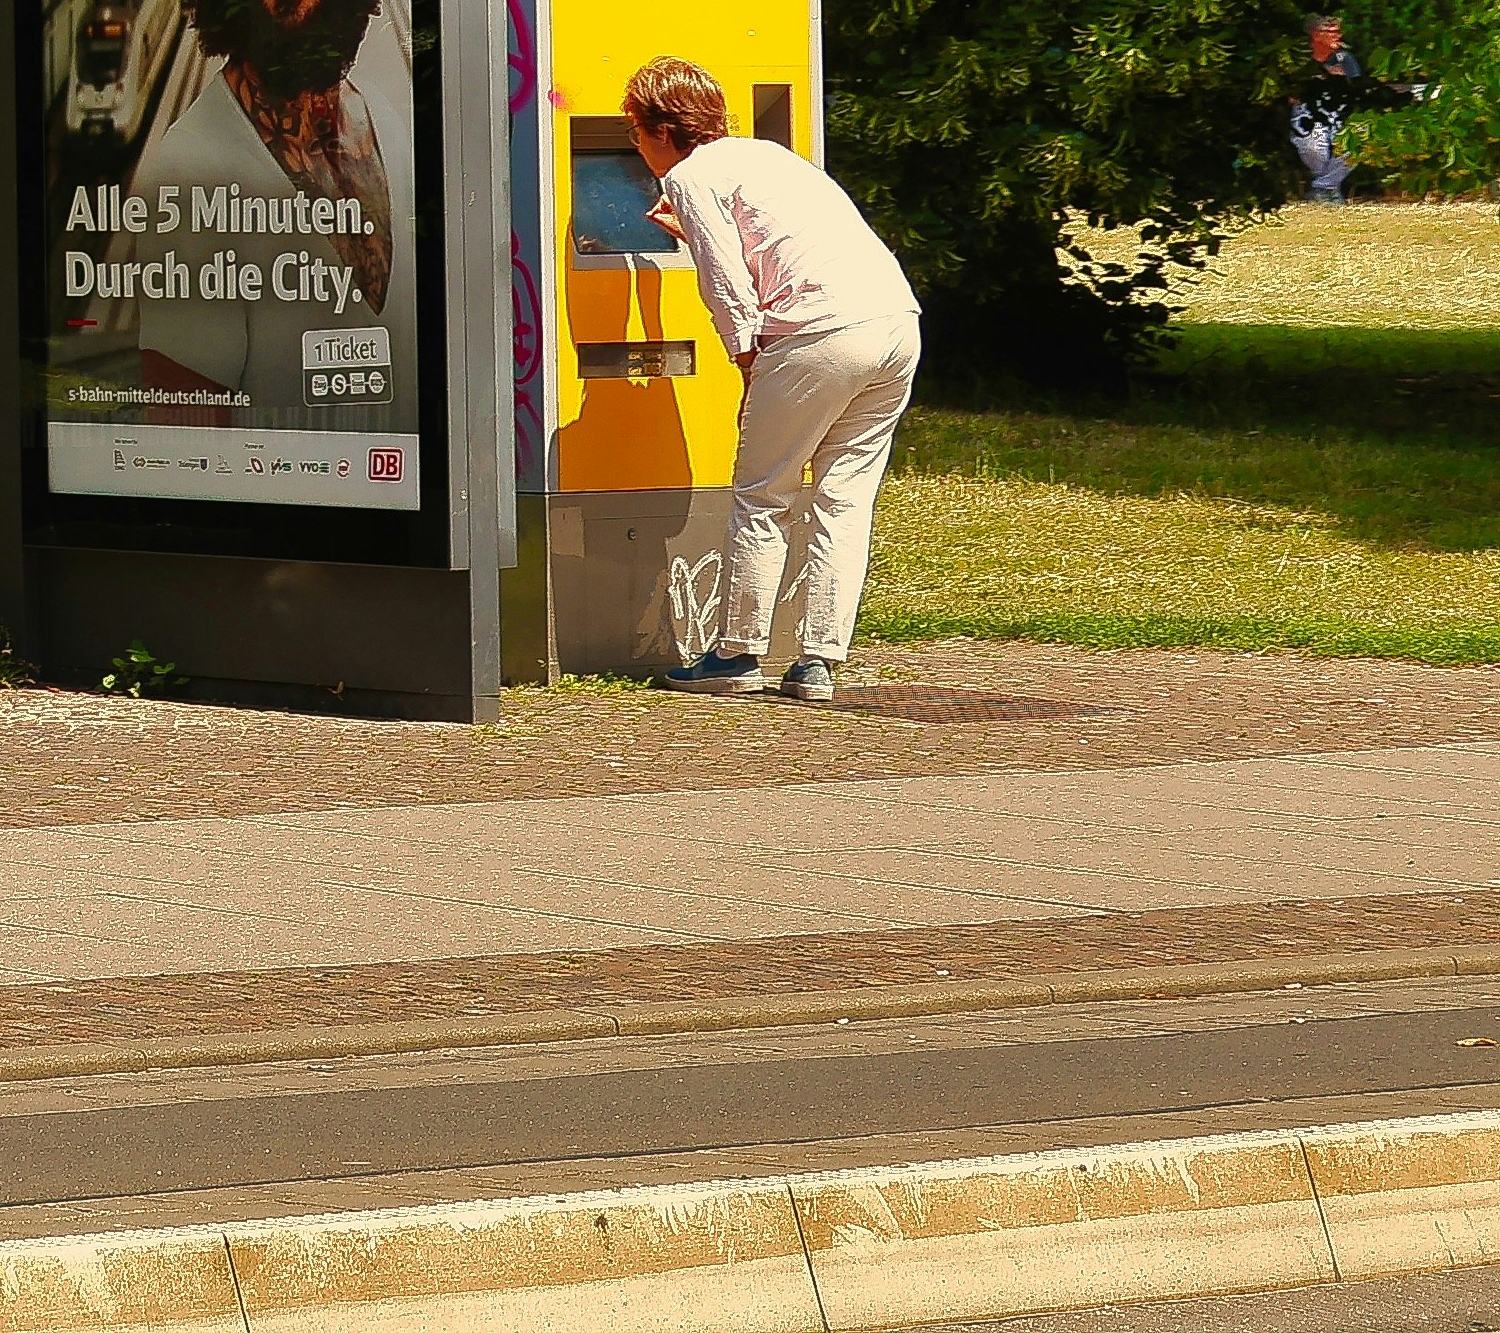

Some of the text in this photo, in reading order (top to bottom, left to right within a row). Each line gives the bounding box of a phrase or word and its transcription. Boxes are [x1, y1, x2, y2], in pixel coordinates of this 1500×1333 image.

[65, 183, 375, 235] Alle 5 Minuten.
[65, 249, 363, 315] Durch die City.
[313, 335, 378, 362] 1 Ticket
[68, 385, 251, 408] s-bahn-mitteldeutschland.de
[335, 376, 345, 392] S
[372, 454, 399, 476] DB
